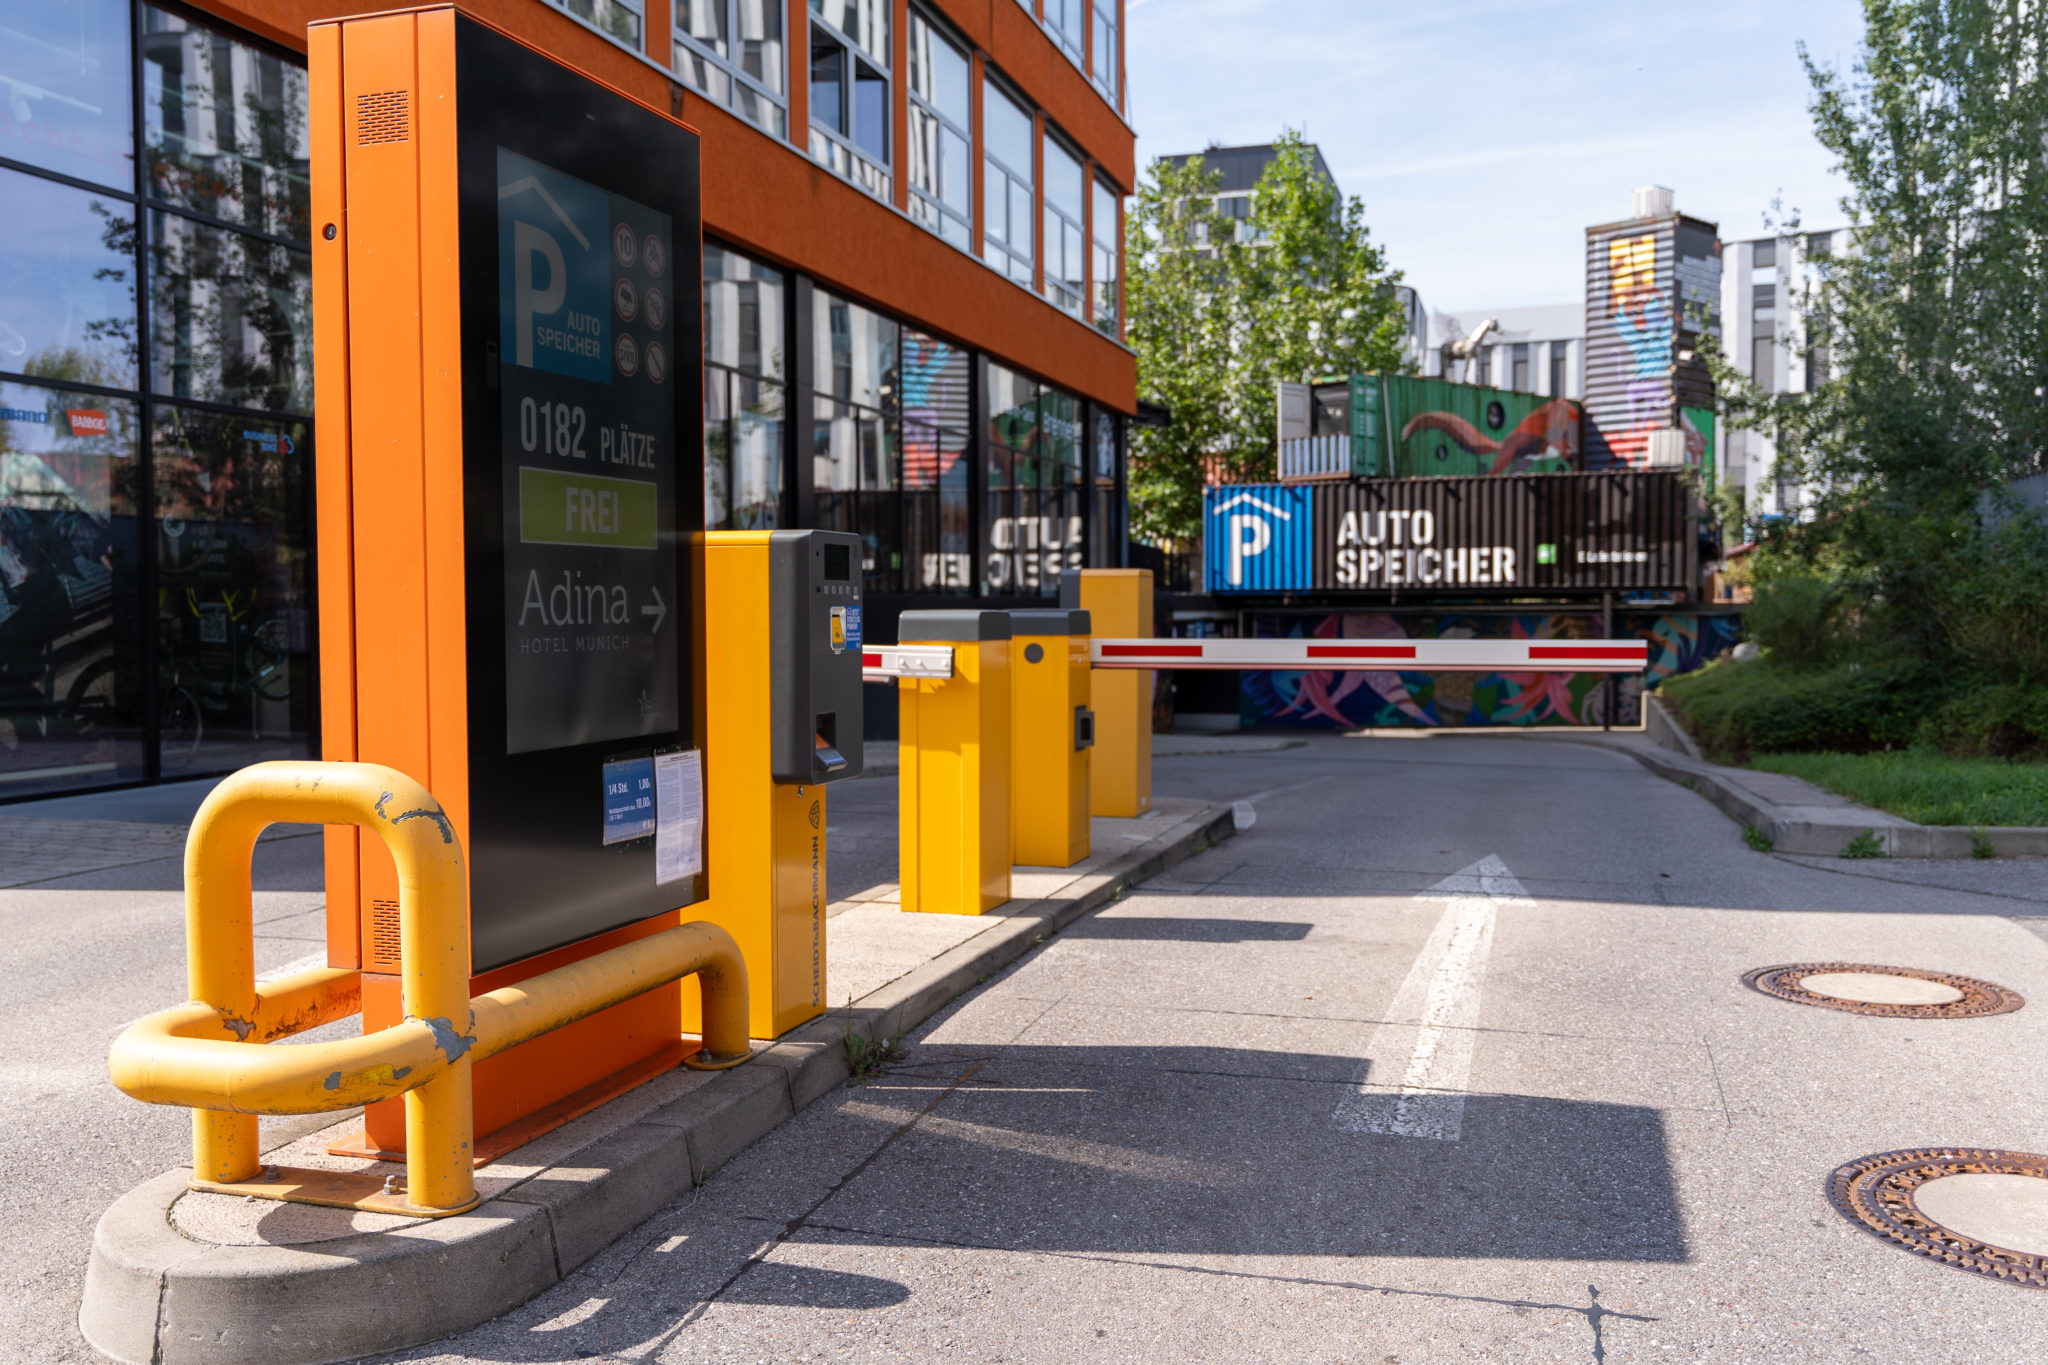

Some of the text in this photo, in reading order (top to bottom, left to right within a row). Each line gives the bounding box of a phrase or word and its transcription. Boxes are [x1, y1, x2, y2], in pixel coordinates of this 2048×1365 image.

[619, 234, 632, 256] 10
[514, 219, 566, 368] P
[567, 310, 600, 336] AUTO
[536, 326, 600, 360] SPEICHER
[520, 396, 655, 469] 0182 PLÄTZE
[565, 486, 620, 534] FREI
[1336, 509, 1435, 546] AUTO
[1228, 513, 1270, 586] P
[1336, 546, 1516, 584] SPEICHER
[518, 568, 630, 626] Adina
[520, 635, 630, 654] HOTEL MUNICH
